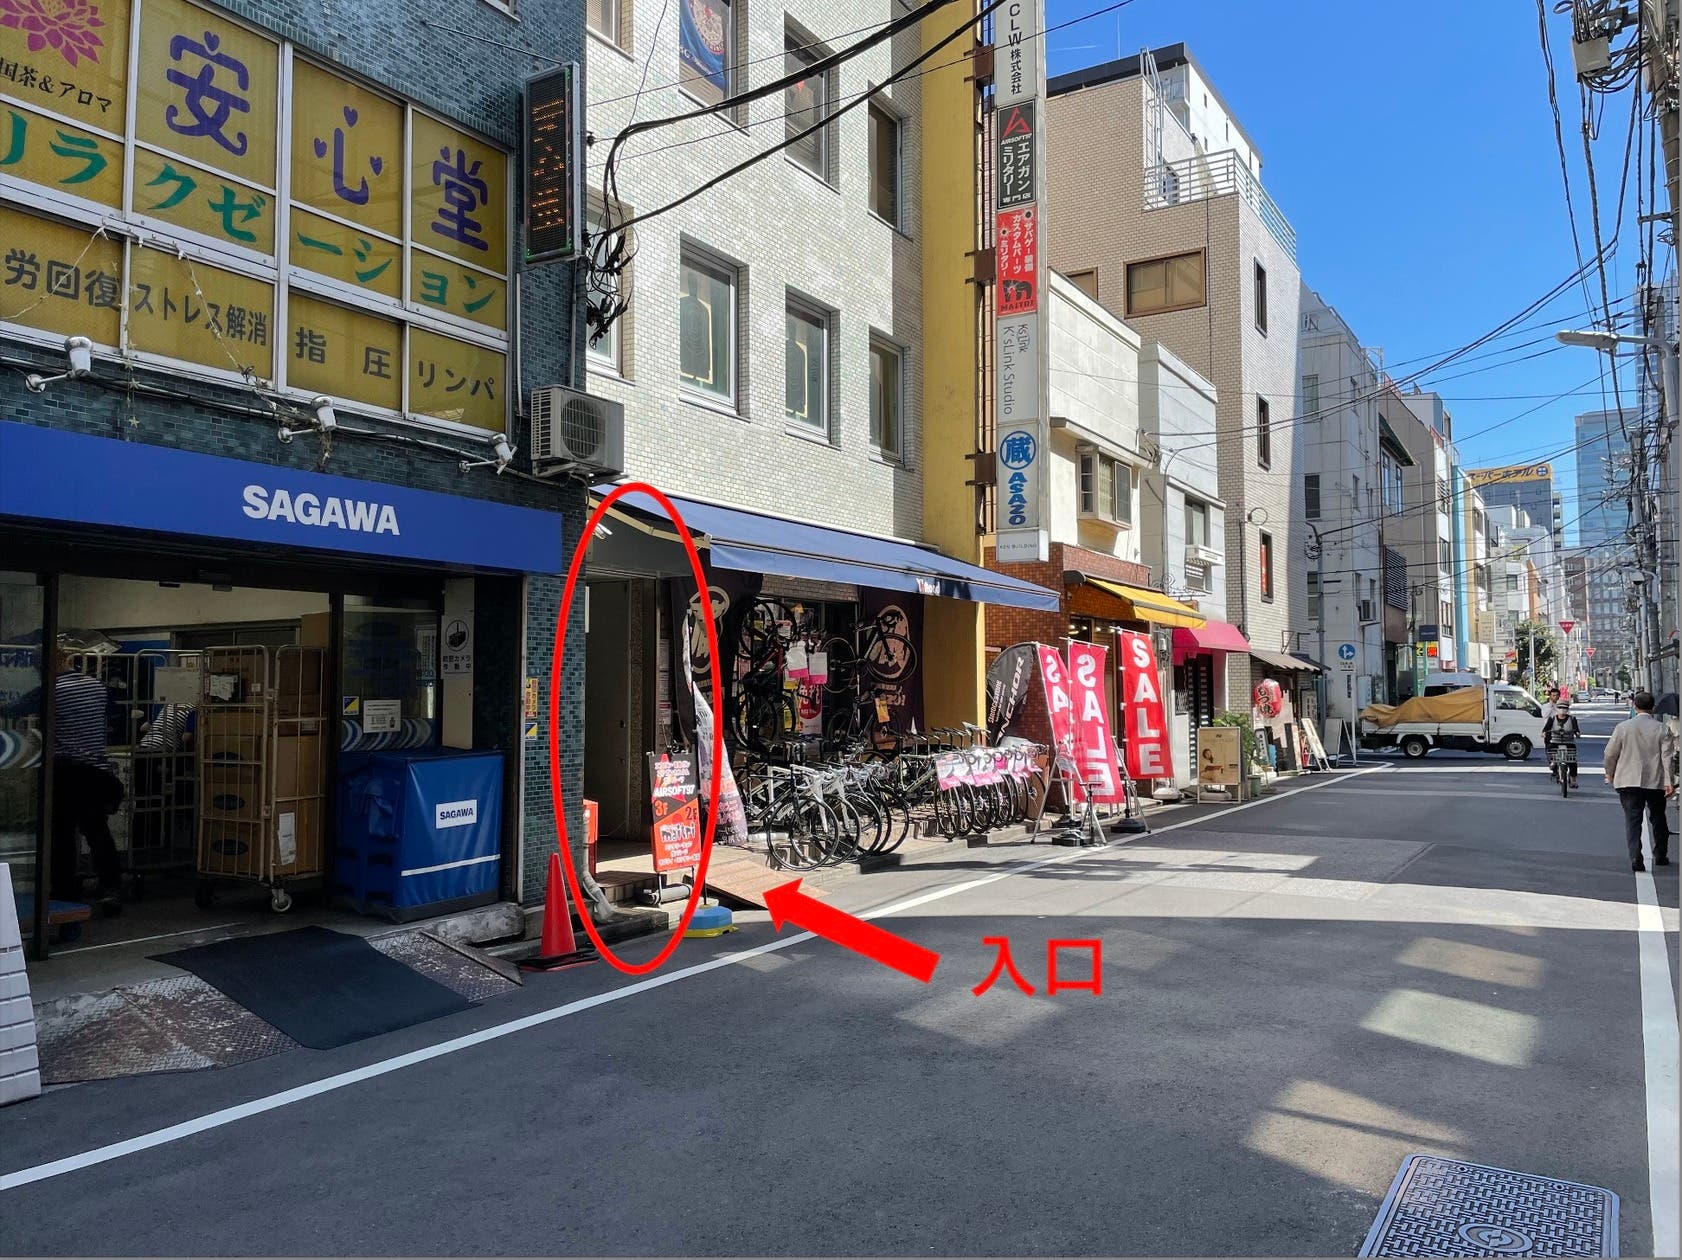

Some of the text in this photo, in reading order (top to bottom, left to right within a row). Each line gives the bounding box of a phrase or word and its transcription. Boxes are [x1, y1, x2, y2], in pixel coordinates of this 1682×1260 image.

[1002, 146, 1014, 195] ミリタリー
[1017, 141, 1031, 191] エアガン
[1000, 240, 1009, 277] ミリタリー
[134, 284, 267, 346] ストレス解消
[295, 327, 391, 380] 指圧
[418, 360, 494, 400] リンパ
[1003, 373, 1015, 415] Studio
[1004, 436, 1033, 464] 蔵
[242, 484, 401, 536] SAGAWA
[1007, 471, 1028, 526] ASAZO
[1131, 638, 1165, 775] SALE
[439, 806, 474, 821] SAGAWA
